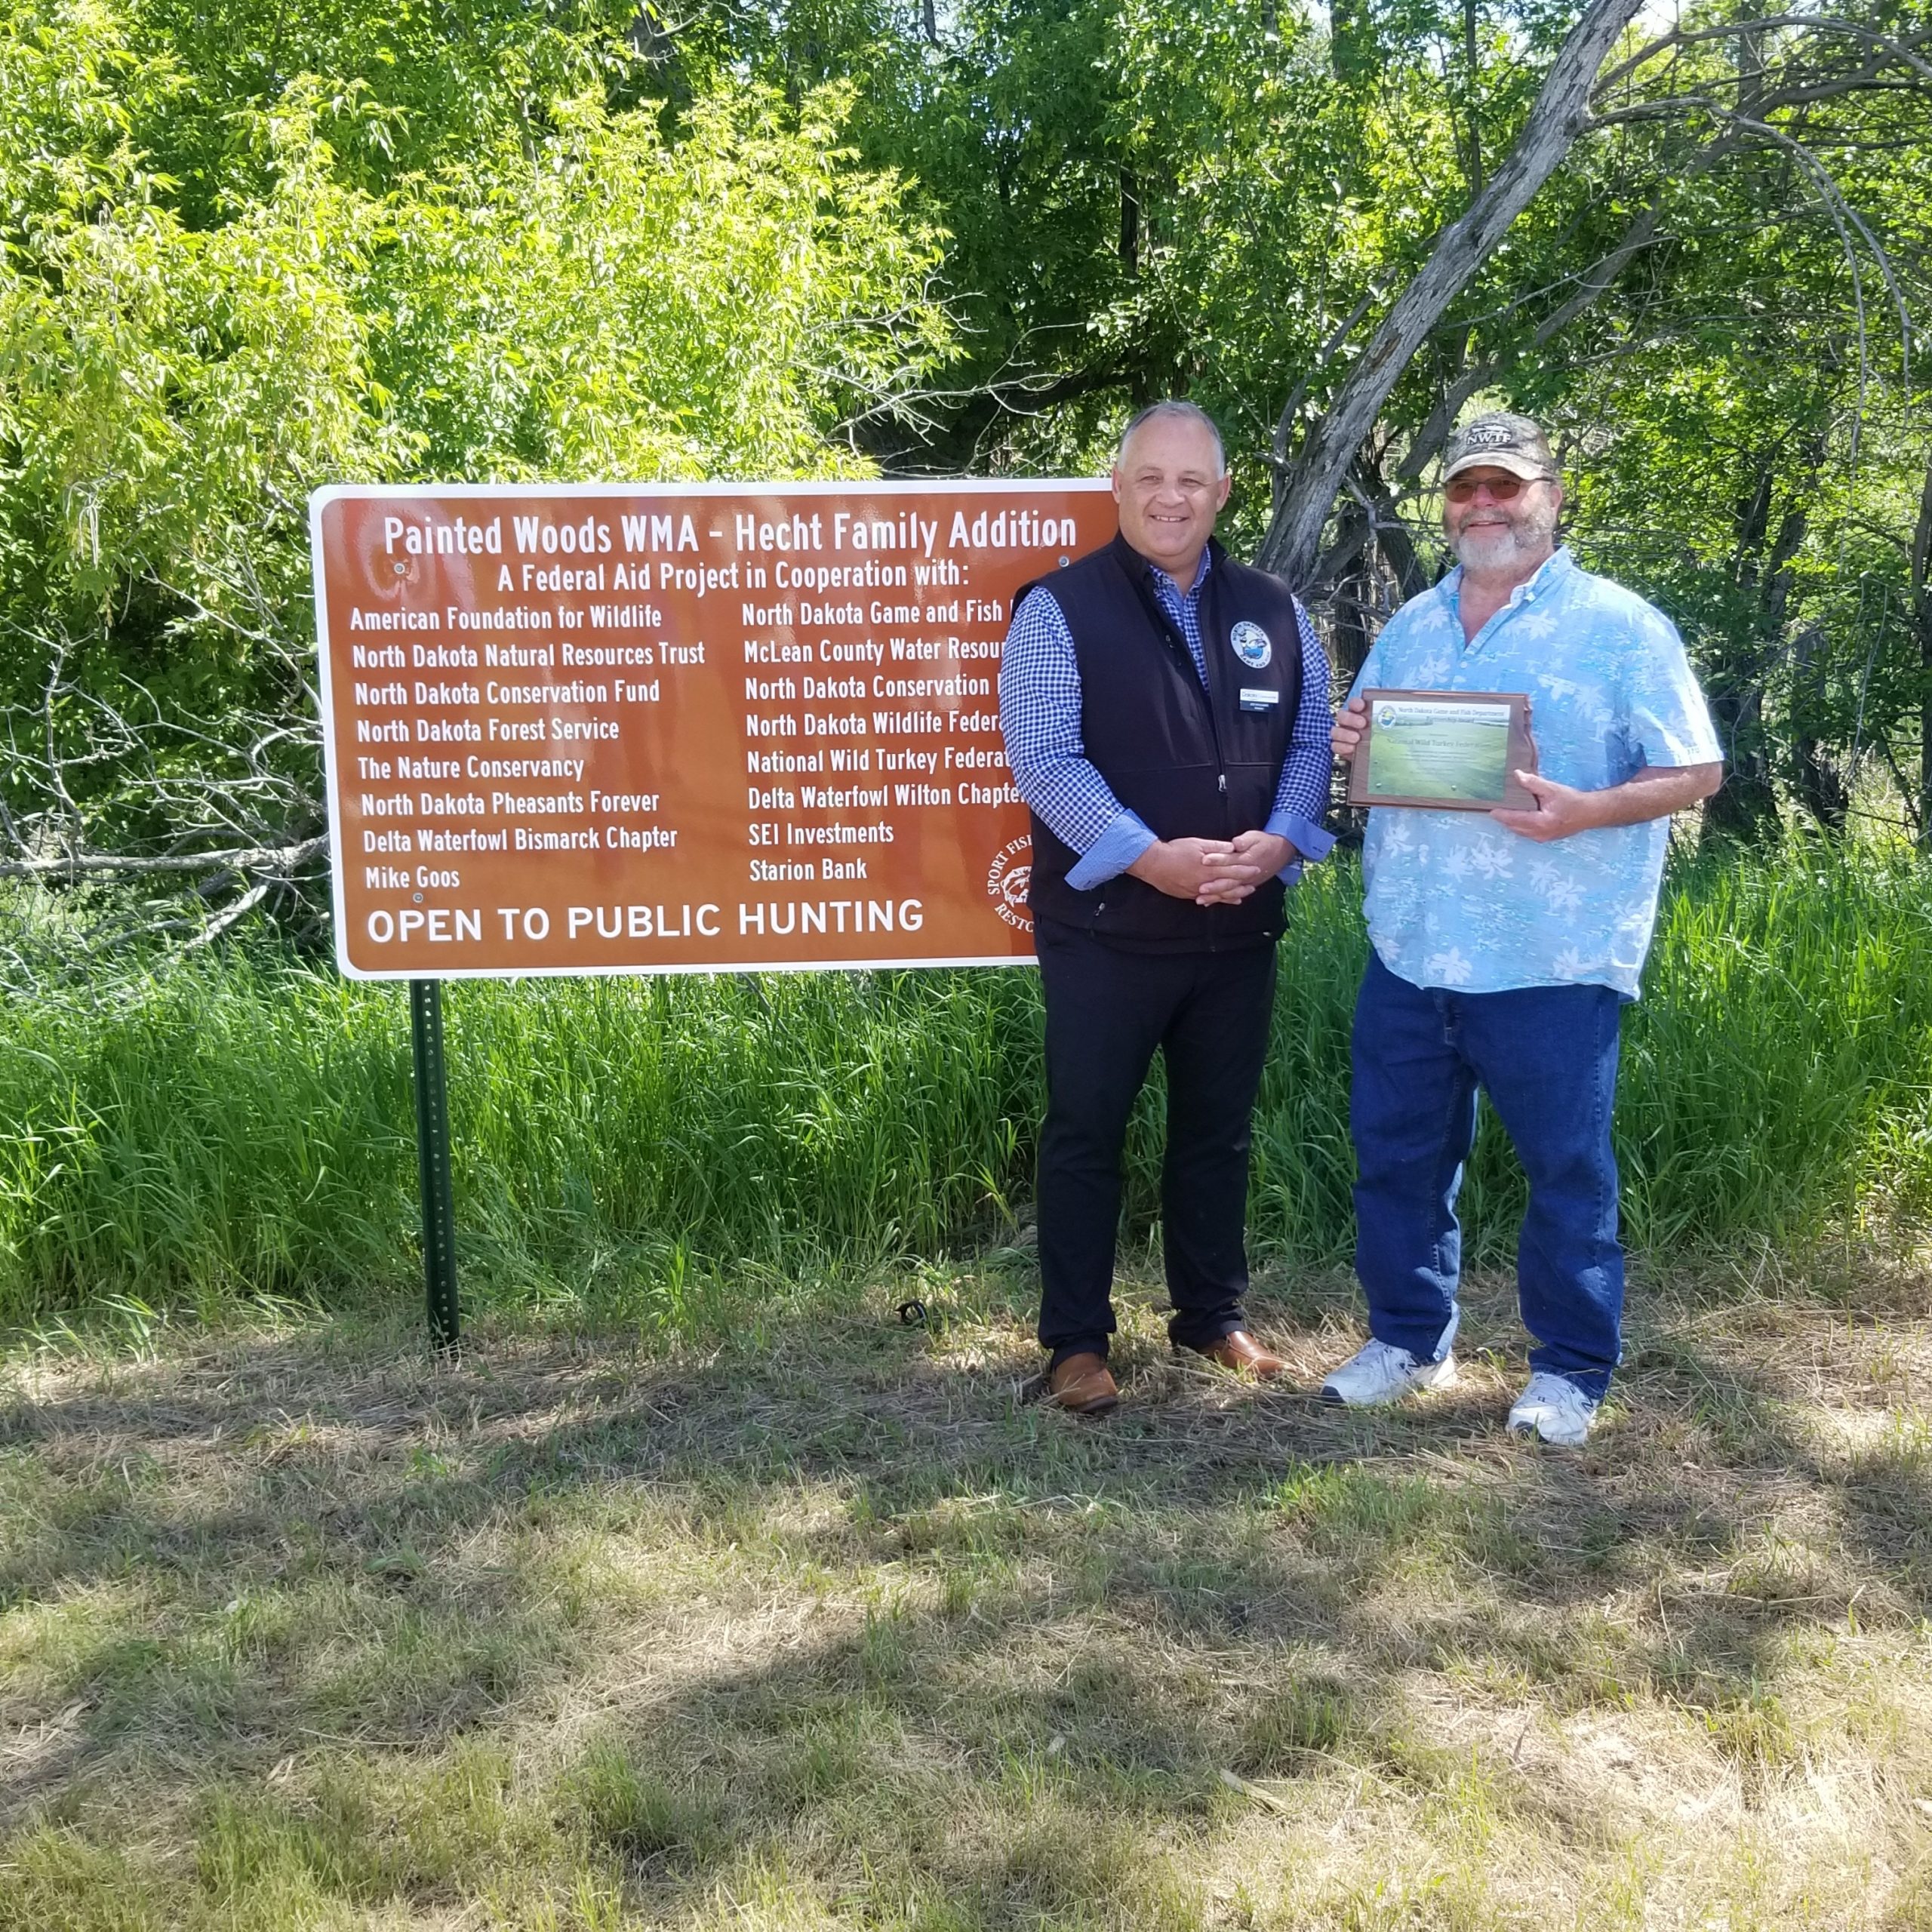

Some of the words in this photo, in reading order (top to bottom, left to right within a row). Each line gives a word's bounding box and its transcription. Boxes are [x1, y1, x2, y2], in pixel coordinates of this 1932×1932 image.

[1466, 431, 1512, 445] NWTF
[383, 513, 502, 555] Painted
[512, 515, 612, 554] Woods
[620, 514, 700, 552] WMA
[735, 512, 823, 552] Hecht
[834, 512, 938, 558] Family
[949, 509, 1076, 548] Addition
[497, 564, 514, 592] A
[522, 563, 605, 592] Federal
[613, 562, 651, 590] Aid
[660, 561, 740, 598] Project
[746, 561, 767, 589] in
[775, 559, 906, 594] Cooperation
[914, 557, 968, 586] with:
[350, 606, 440, 630] American
[447, 606, 552, 630] Foundation
[558, 605, 584, 629] for
[589, 604, 662, 628] Wildlife
[742, 602, 793, 626] North
[800, 601, 863, 625] Dakota
[870, 601, 921, 624] Game
[925, 599, 958, 623] and
[966, 599, 1002, 622] Fish
[352, 645, 406, 668] North
[413, 645, 478, 667] Dakota
[485, 644, 555, 667] Natural
[561, 643, 654, 666] Resources
[658, 641, 705, 664] Trust
[744, 640, 813, 663] McLean
[820, 638, 884, 666] County
[890, 638, 942, 660] Water
[355, 682, 408, 706] North
[414, 681, 480, 705] Dakota
[487, 680, 608, 704] Conservation
[614, 679, 660, 702] Fund
[746, 677, 795, 700] North
[803, 675, 866, 699] Dakota
[872, 673, 989, 698] Conservation
[357, 719, 410, 743] North
[417, 718, 481, 742] Dakota
[488, 718, 546, 741] Forest
[551, 717, 620, 741] Service
[746, 714, 797, 737] North
[804, 712, 866, 736] Dakota
[872, 710, 942, 734] Wildlife
[357, 757, 392, 780] The
[398, 756, 460, 779] Nature
[466, 755, 584, 782] Conservancy
[747, 749, 823, 773] National
[829, 749, 869, 771] Wild
[875, 748, 937, 774] Turkey
[361, 793, 414, 817] North
[420, 792, 485, 815] Dakota
[492, 791, 584, 814] Pheasants
[590, 790, 660, 813] Forever
[749, 786, 795, 809] Delta
[801, 784, 888, 808] Waterfowl
[894, 783, 951, 806] Wilton
[958, 782, 1026, 808] Chapte
[363, 830, 411, 853] Delta
[417, 829, 507, 851] Waterfowl
[515, 827, 600, 851] Bismarck
[606, 826, 678, 853] Chapter
[749, 823, 779, 846] SEI
[787, 820, 894, 844] Investments
[365, 866, 411, 889] Mike
[416, 866, 460, 888] Goos
[749, 859, 814, 881] Starion
[822, 857, 867, 880] Bank
[987, 851, 1009, 895] SPORT
[368, 909, 481, 943] OPEN
[497, 907, 549, 940] TO
[568, 903, 721, 939] PUBLIC
[739, 899, 923, 935] HUNTING
